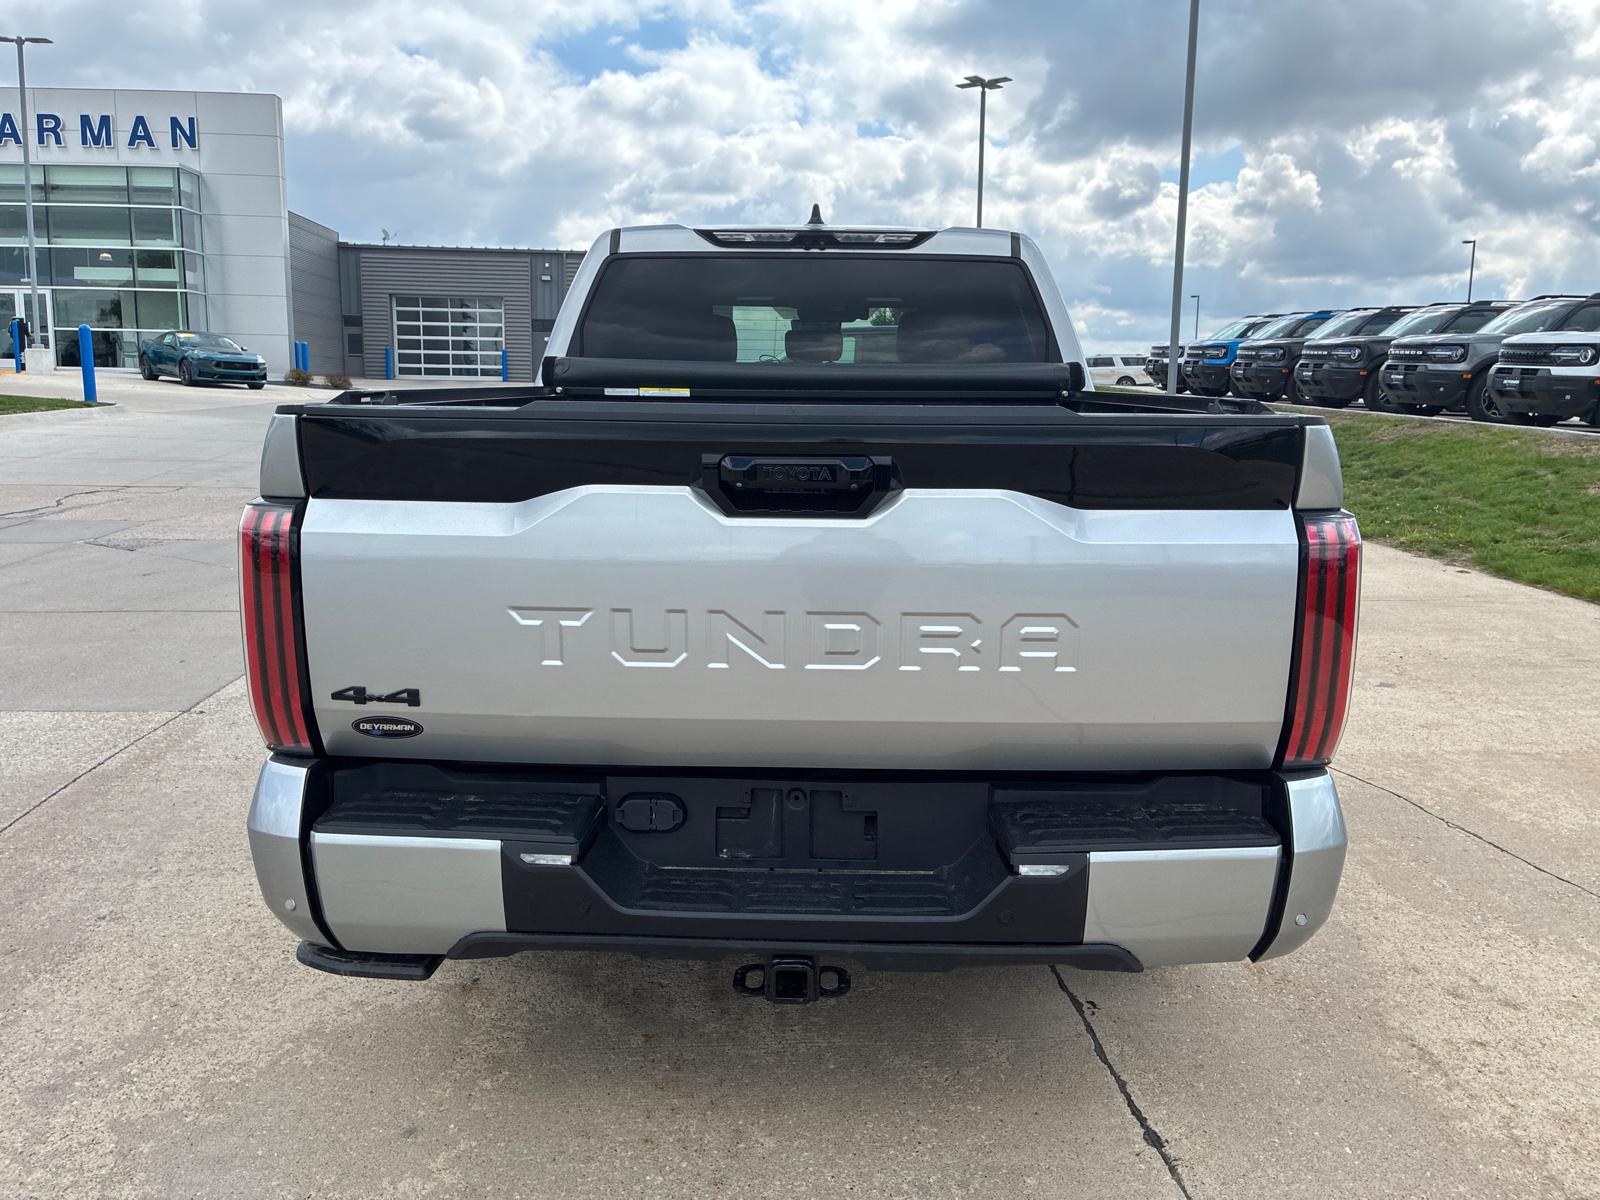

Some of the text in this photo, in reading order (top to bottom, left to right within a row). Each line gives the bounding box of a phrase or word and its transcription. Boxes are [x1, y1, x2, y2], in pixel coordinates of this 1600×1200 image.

[0, 112, 198, 150] ARMAN
[762, 466, 832, 481] TOYOTA
[507, 606, 1079, 673] TUNDRA
[360, 723, 415, 731] DEYARMAN
